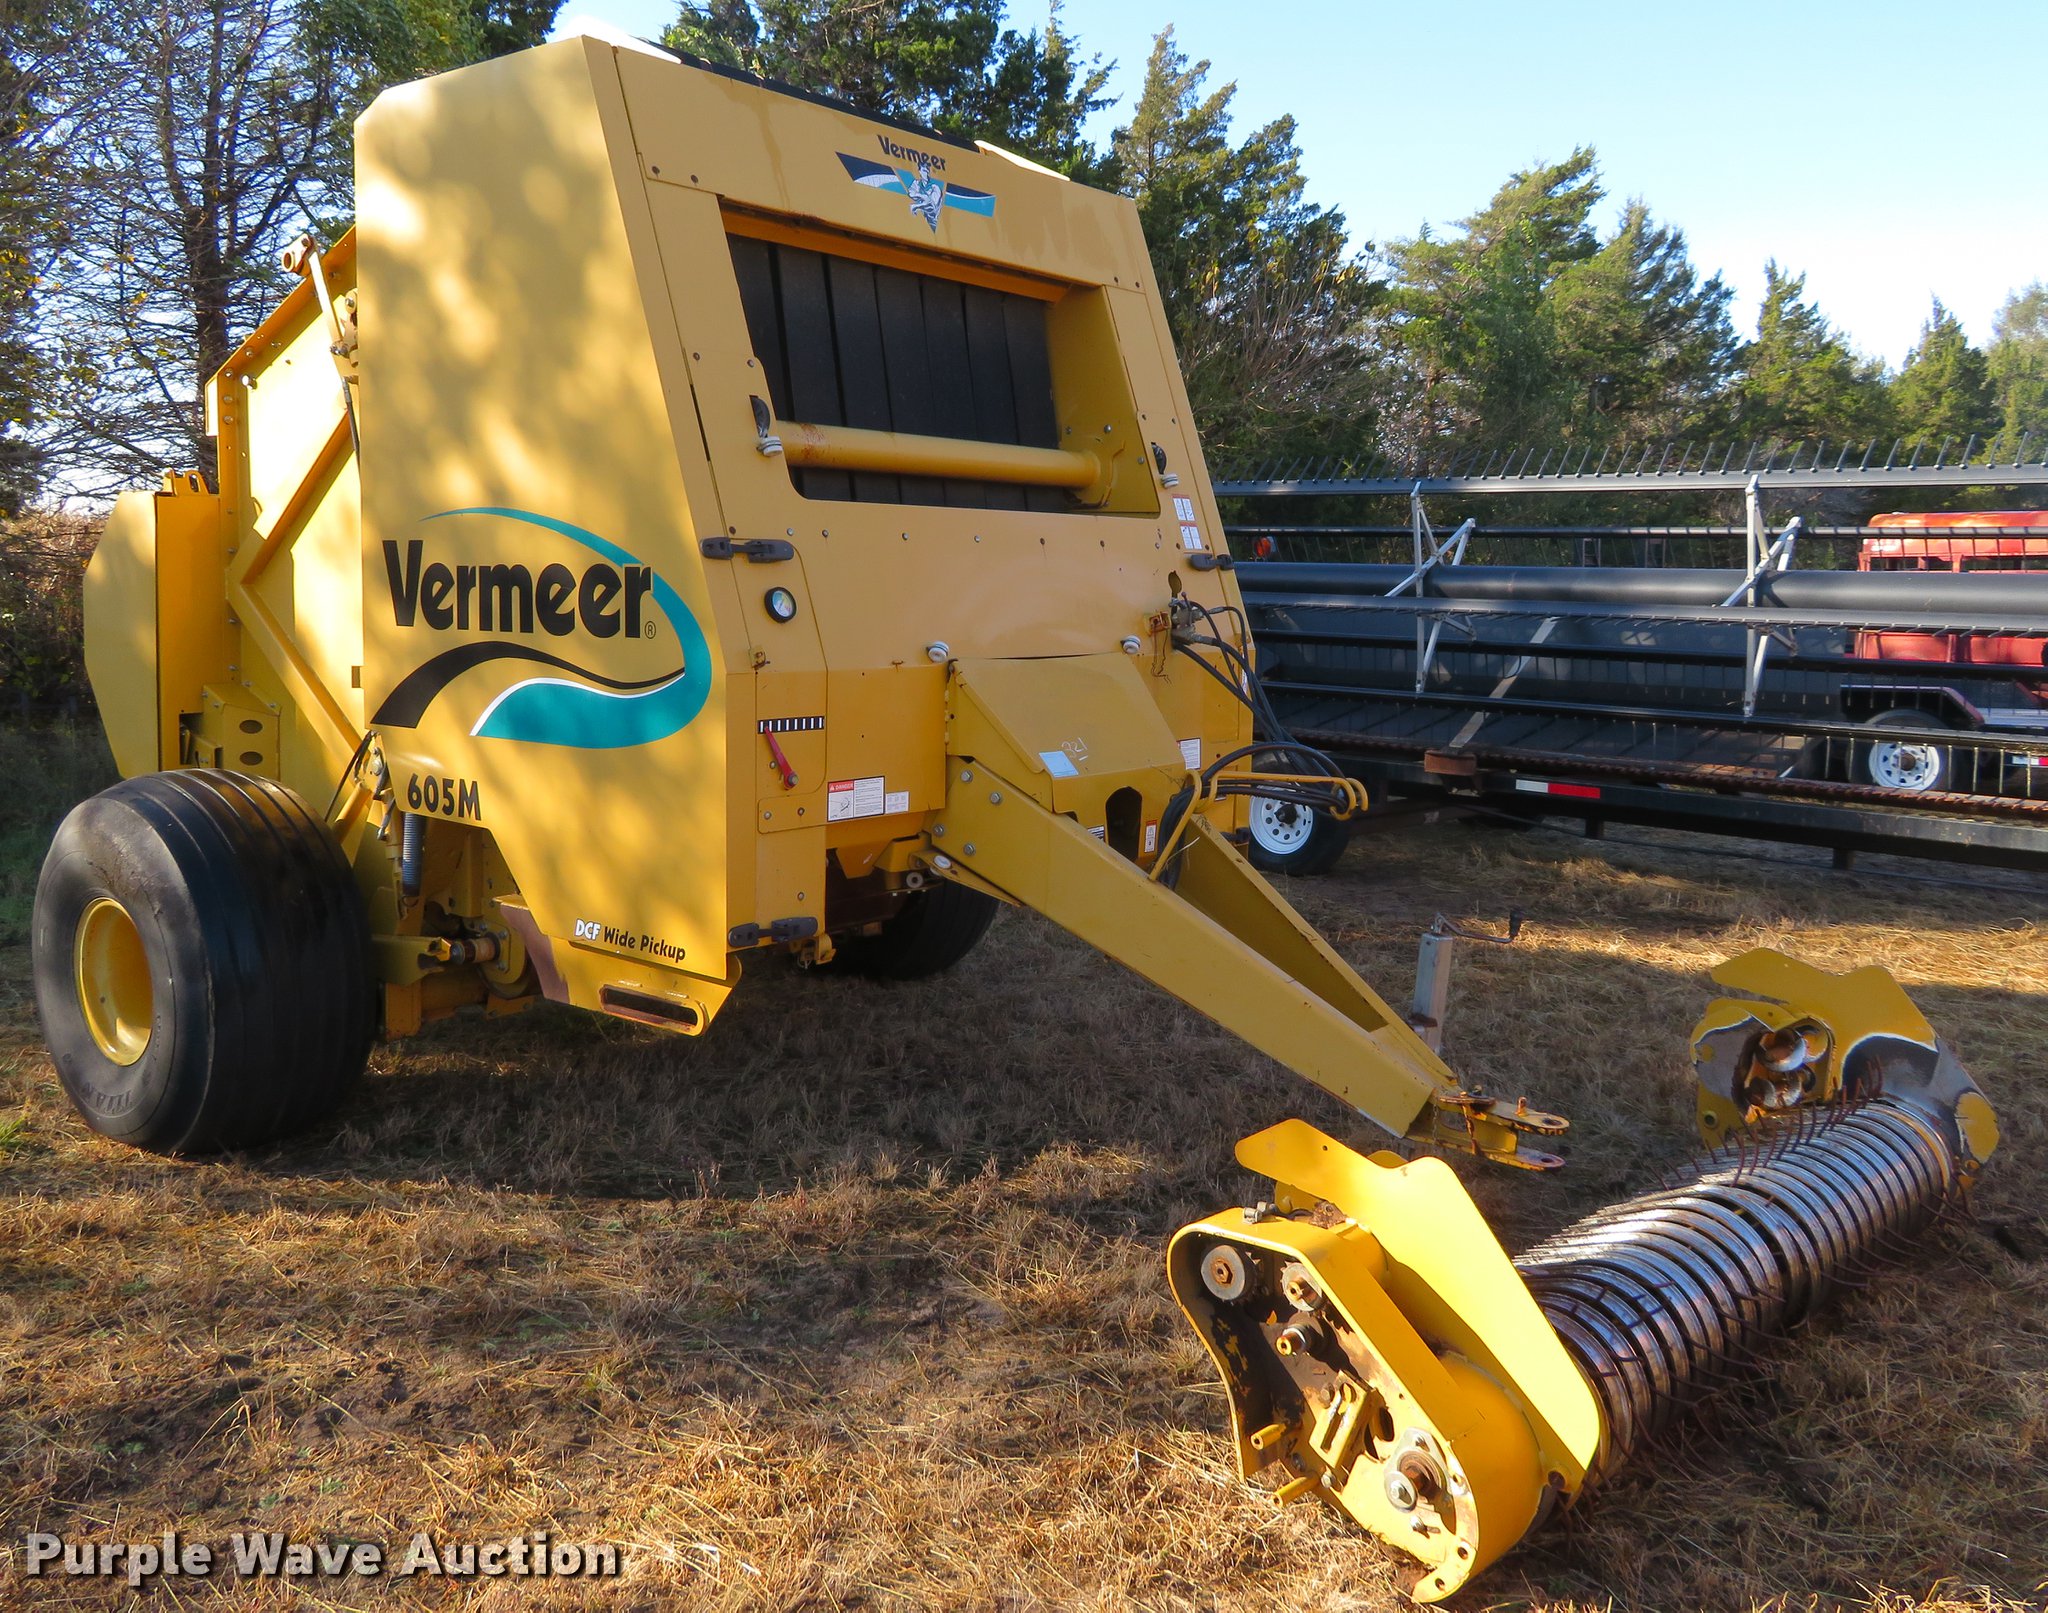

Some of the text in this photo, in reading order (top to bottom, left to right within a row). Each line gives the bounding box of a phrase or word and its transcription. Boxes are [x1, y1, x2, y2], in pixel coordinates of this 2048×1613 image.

[877, 134, 946, 171] Vermeer
[382, 540, 652, 639] Vermeer
[407, 773, 482, 821] 605M
[574, 918, 686, 963] DCF Wide Pickup
